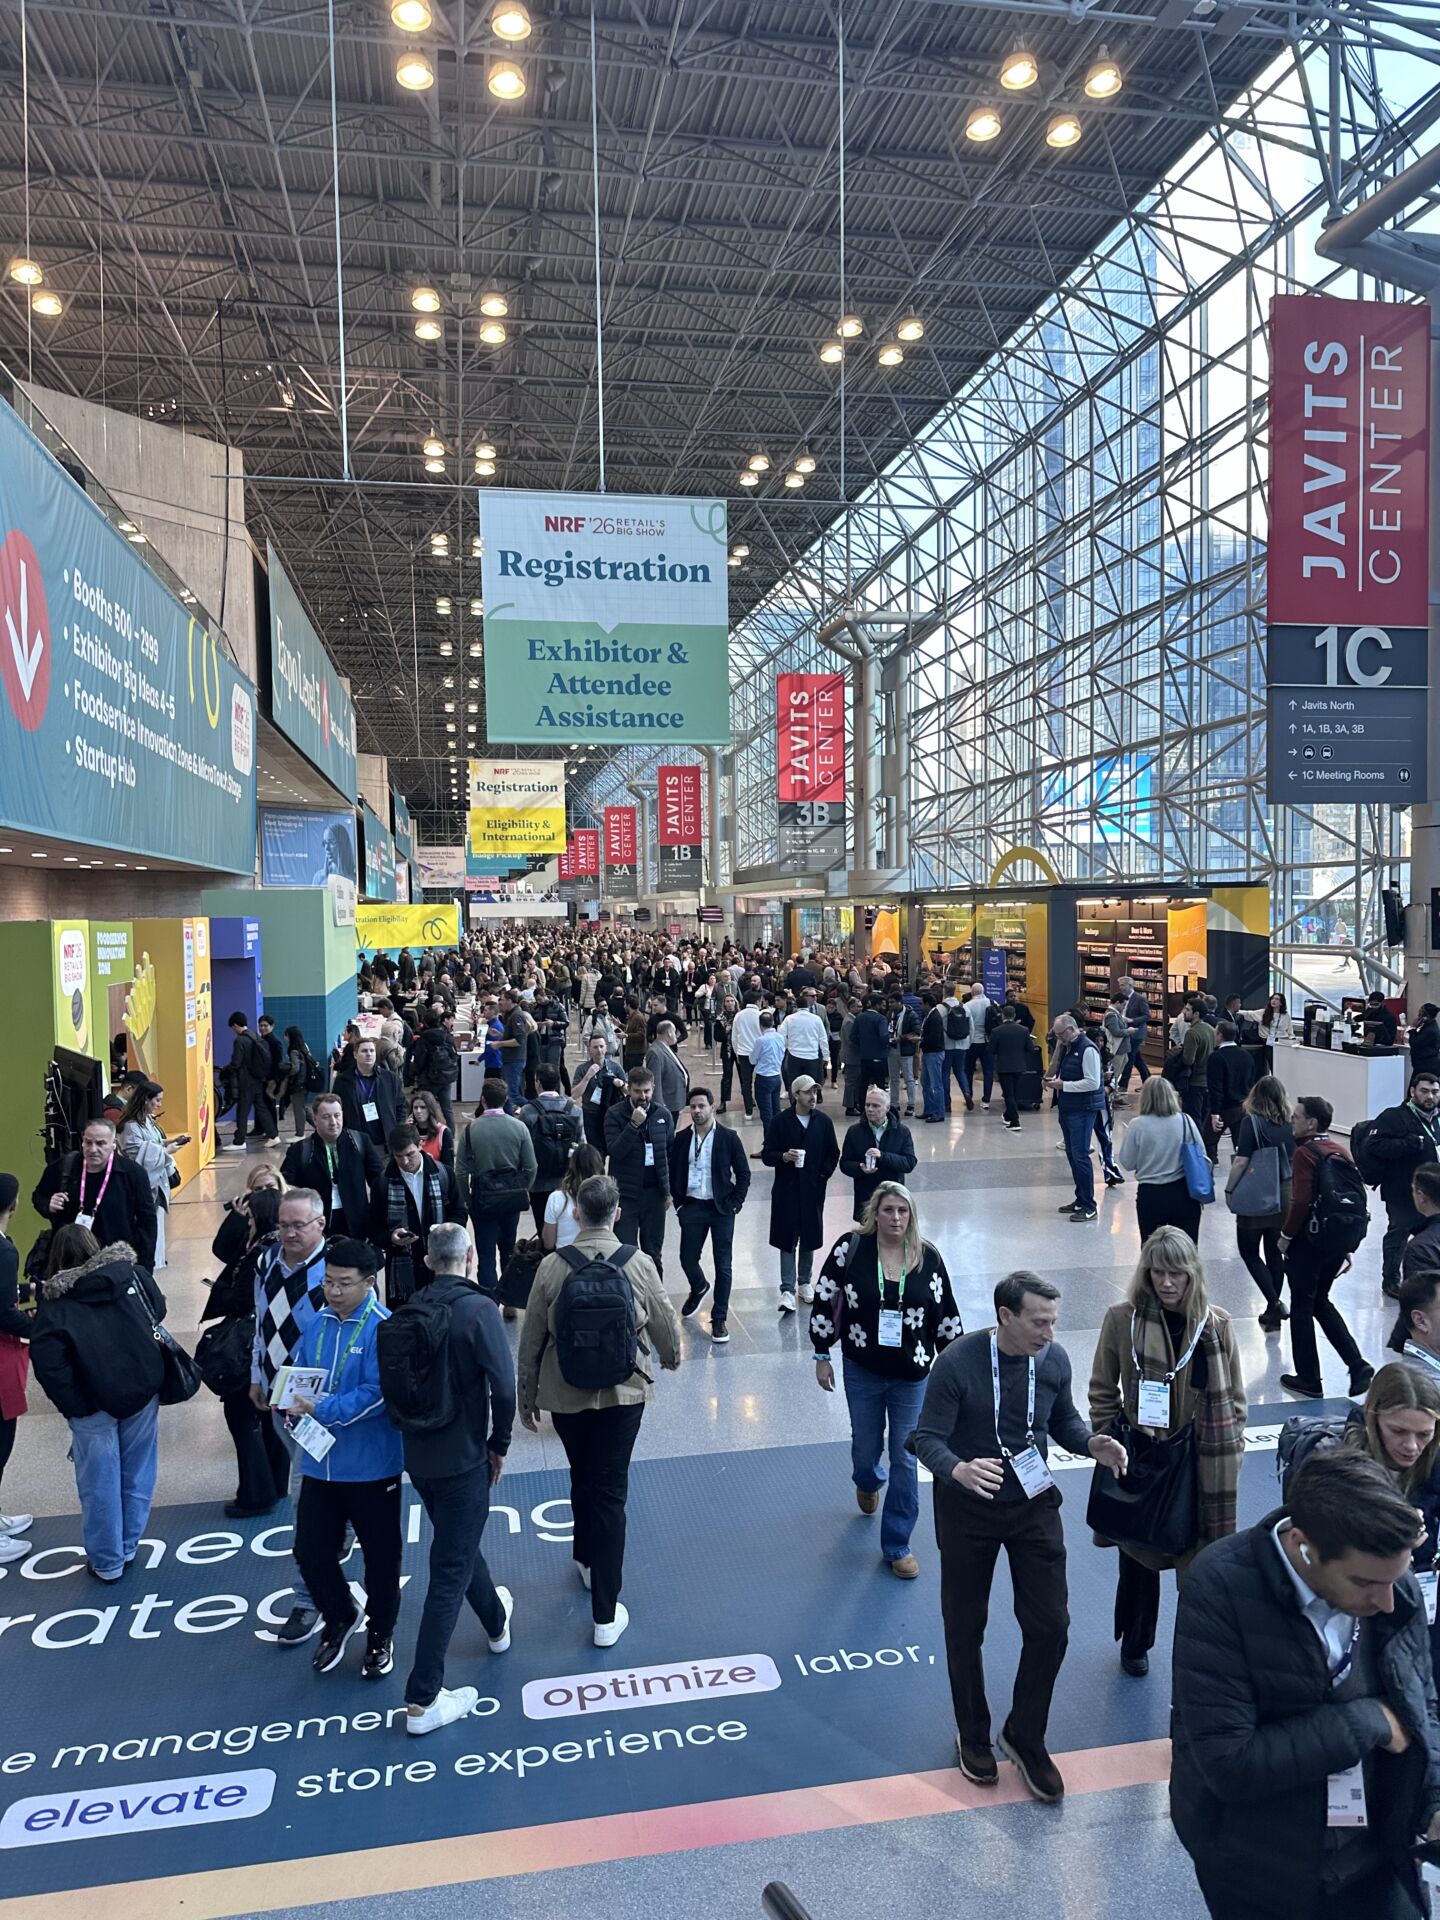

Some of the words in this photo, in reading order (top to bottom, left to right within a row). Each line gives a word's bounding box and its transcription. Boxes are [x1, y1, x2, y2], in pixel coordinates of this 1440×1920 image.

[1302, 340, 1348, 579] JAVITS
[1368, 345, 1403, 585] CENTER
[545, 515, 586, 533] NRF
[589, 517, 615, 535] '26
[616, 518, 666, 528] RETAIL'S
[616, 527, 633, 536] BIG
[636, 528, 666, 537] SHOW
[497, 549, 712, 587] Registration
[73, 567, 114, 626] Booths
[114, 607, 132, 643] 500
[140, 625, 159, 666] 2999
[527, 638, 662, 664] Exhibitor
[667, 641, 689, 664] &
[1314, 625, 1393, 687] 1C
[73, 623, 122, 684] Exhibitor
[123, 659, 137, 704] Big
[138, 671, 161, 711] Ideas
[160, 689, 176, 721] 4-5
[546, 672, 672, 696] Attendee
[74, 678, 136, 741] Foodservice
[137, 716, 178, 764] Innovation
[535, 704, 685, 729] Assistance
[1302, 701, 1328, 710] Javits
[1330, 701, 1355, 710] North
[789, 691, 810, 785] JAVITS
[818, 690, 834, 785] CENTER
[1302, 724, 1316, 735] 1A,
[1318, 724, 1333, 735] 1B,
[1334, 724, 1350, 735] 3A,
[1352, 724, 1365, 734] 3B
[75, 734, 117, 789] Startup
[118, 757, 136, 789] Hub
[1302, 771, 1314, 780] 1C
[1316, 771, 1351, 782] Meeting
[1353, 771, 1385, 780] Rooms
[476, 781, 559, 793] Registration
[666, 776, 680, 835] JAVITS
[684, 775, 695, 835] CENTER
[796, 802, 830, 826] 3B
[482, 832, 556, 841] International
[486, 820, 540, 832] Eligibility
[542, 820, 551, 829] &
[610, 814, 620, 857] JAVITS
[623, 813, 632, 857] CENTER
[578, 835, 587, 870] JAVITS
[588, 835, 596, 870] CENTER
[613, 864, 631, 876] 3A
[671, 845, 692, 861] 1B
[581, 875, 594, 885] 1A
[542, 1665, 757, 1711] optimize
[793, 1642, 936, 1677] labor,
[24, 1784, 248, 1832] elevate
[296, 1760, 437, 1798] store
[453, 1719, 749, 1778] experience
